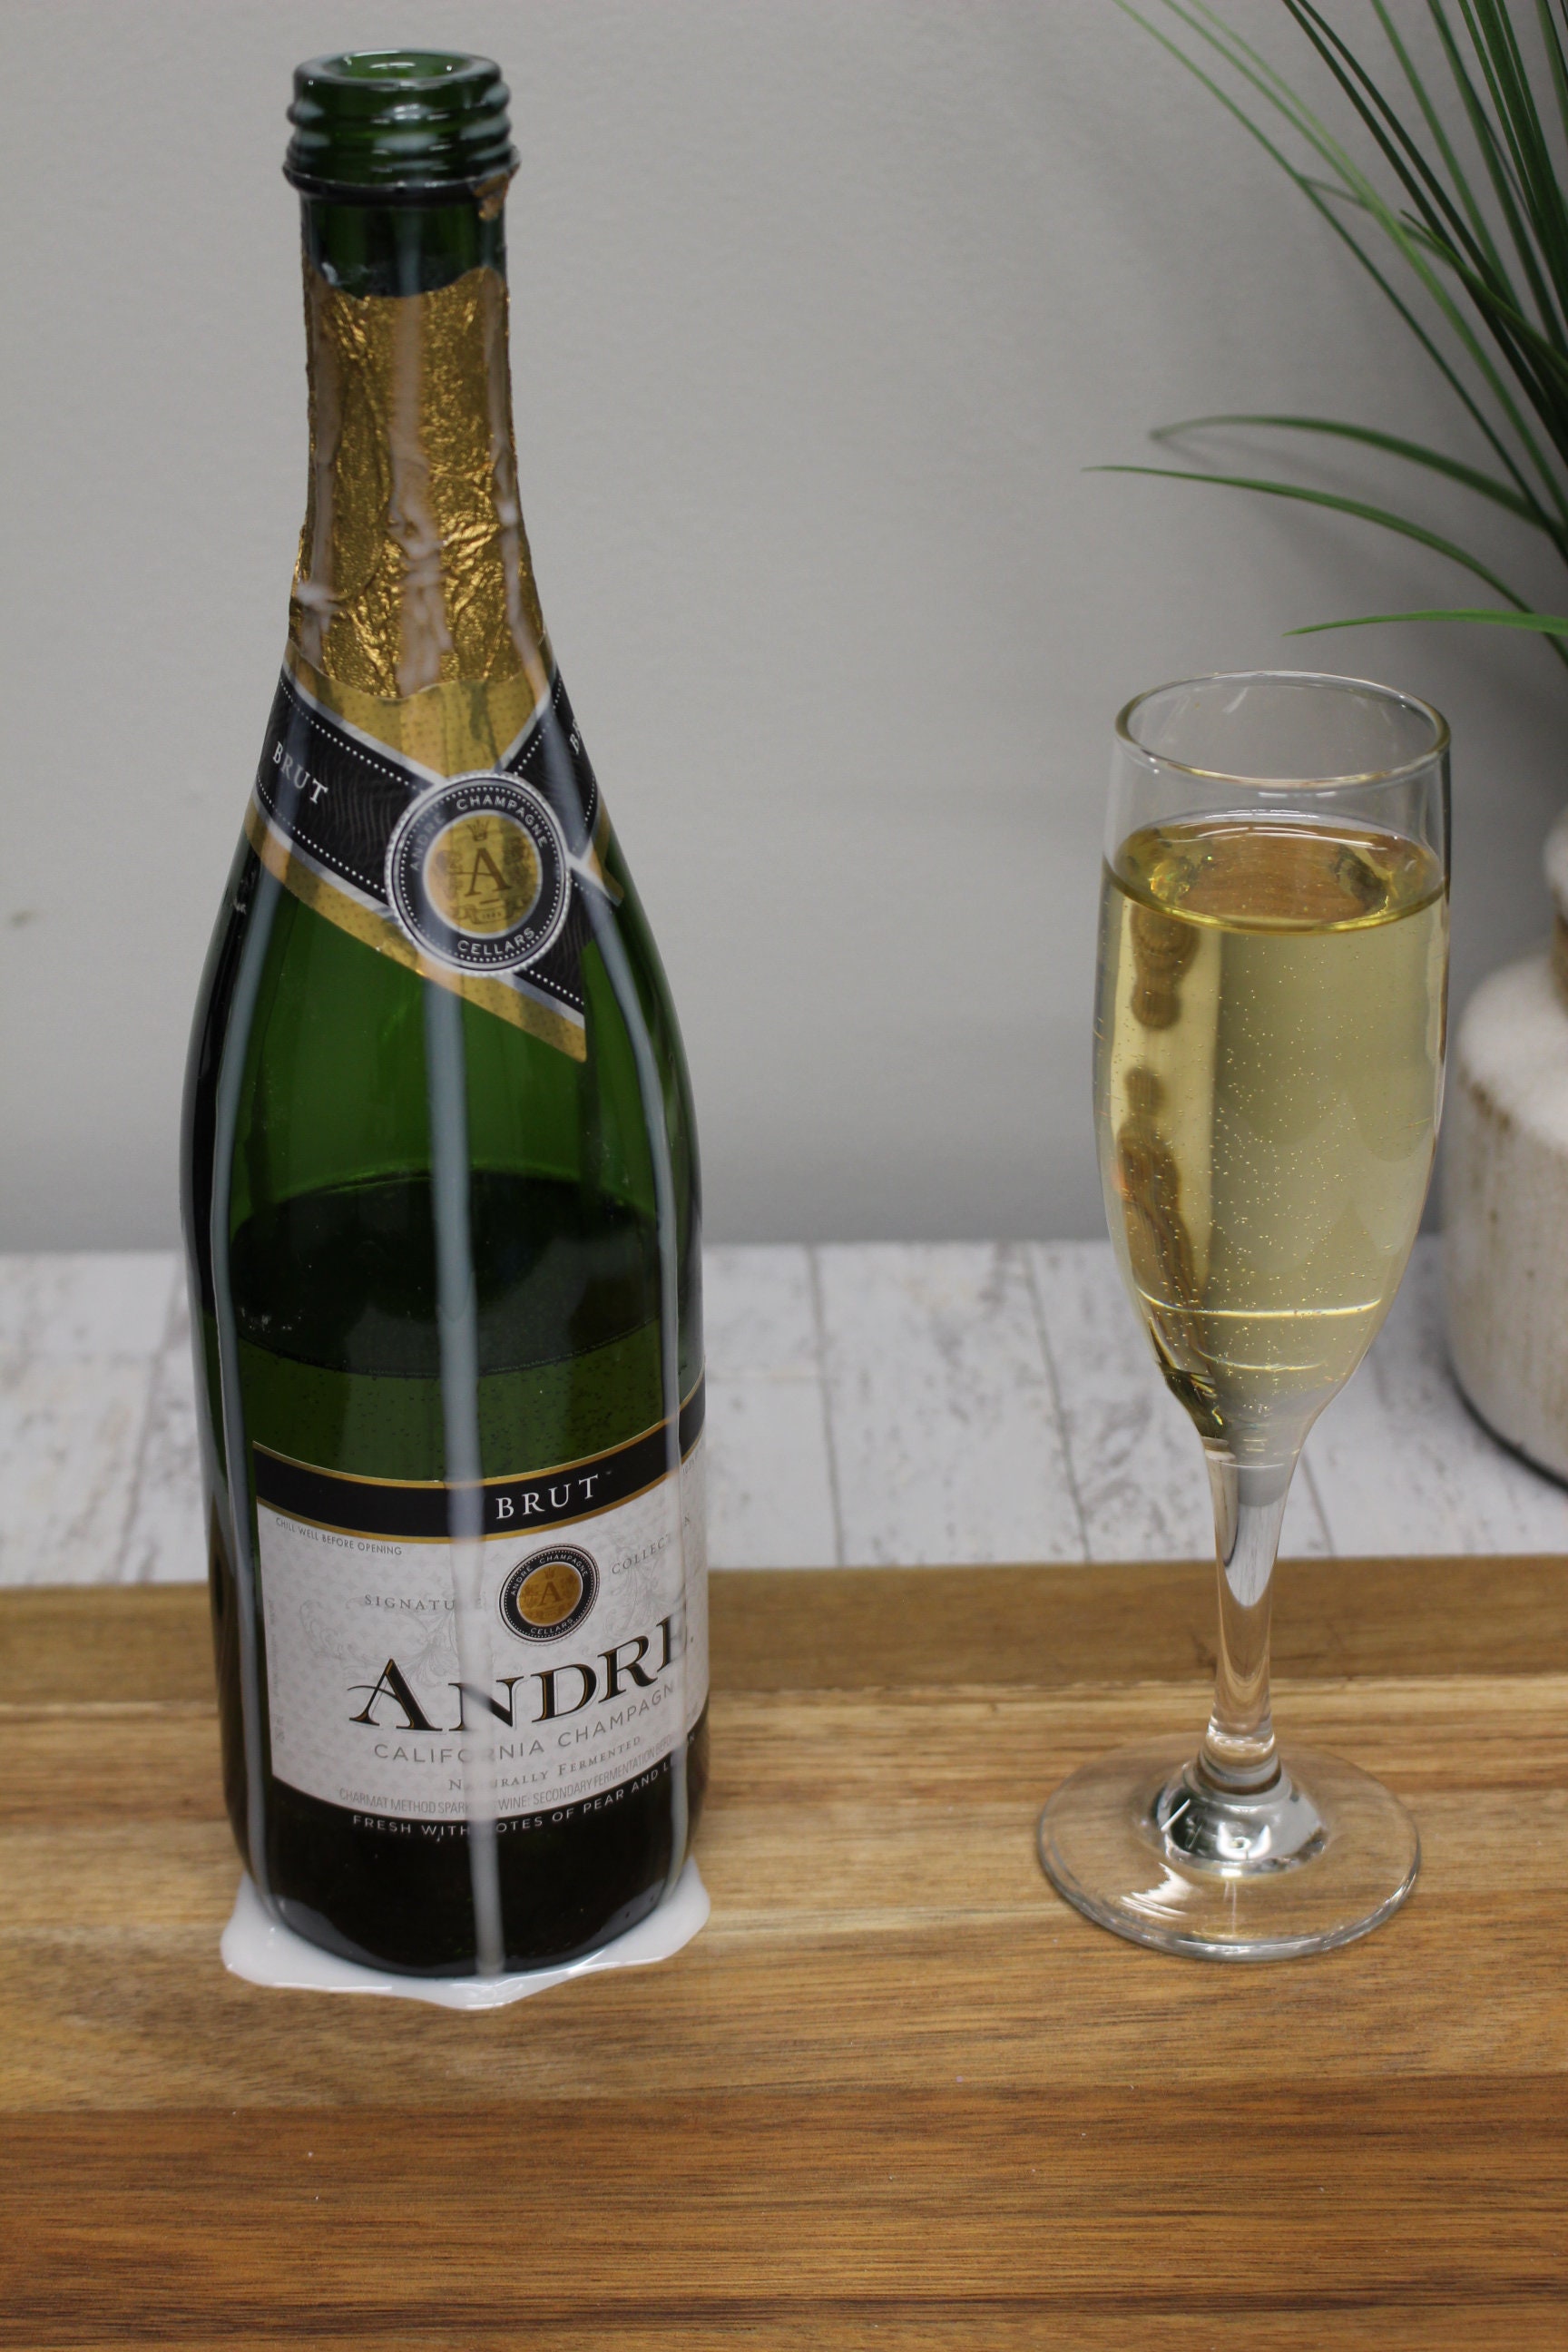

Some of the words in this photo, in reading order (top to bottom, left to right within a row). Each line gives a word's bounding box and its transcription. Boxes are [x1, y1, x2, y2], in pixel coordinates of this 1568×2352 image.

[273, 740, 328, 804] BRUT
[456, 794, 548, 848] CHAMPAGNE
[456, 927, 535, 956] CELLARS
[495, 1473, 599, 1520] BRUT
[275, 1517, 296, 1533] CHILL
[298, 1526, 319, 1542] WELL
[321, 1534, 355, 1550] BEFORE
[357, 1541, 403, 1556] OPENING
[539, 1553, 588, 1577] CHAMPAGNE
[530, 1618, 573, 1634] CELLARS
[557, 1681, 675, 1748] CHAMPAGN
[558, 1736, 642, 1776] FERMENTED
[338, 1788, 388, 1809] CHARMAT
[390, 1798, 436, 1814] METHOD
[533, 1778, 594, 1806] SECONDARY
[353, 1814, 411, 1834] FRESH
[495, 1816, 543, 1833] OTES
[551, 1808, 574, 1822] OF
[583, 1788, 625, 1814] PEAR
[631, 1769, 660, 1793] AND
